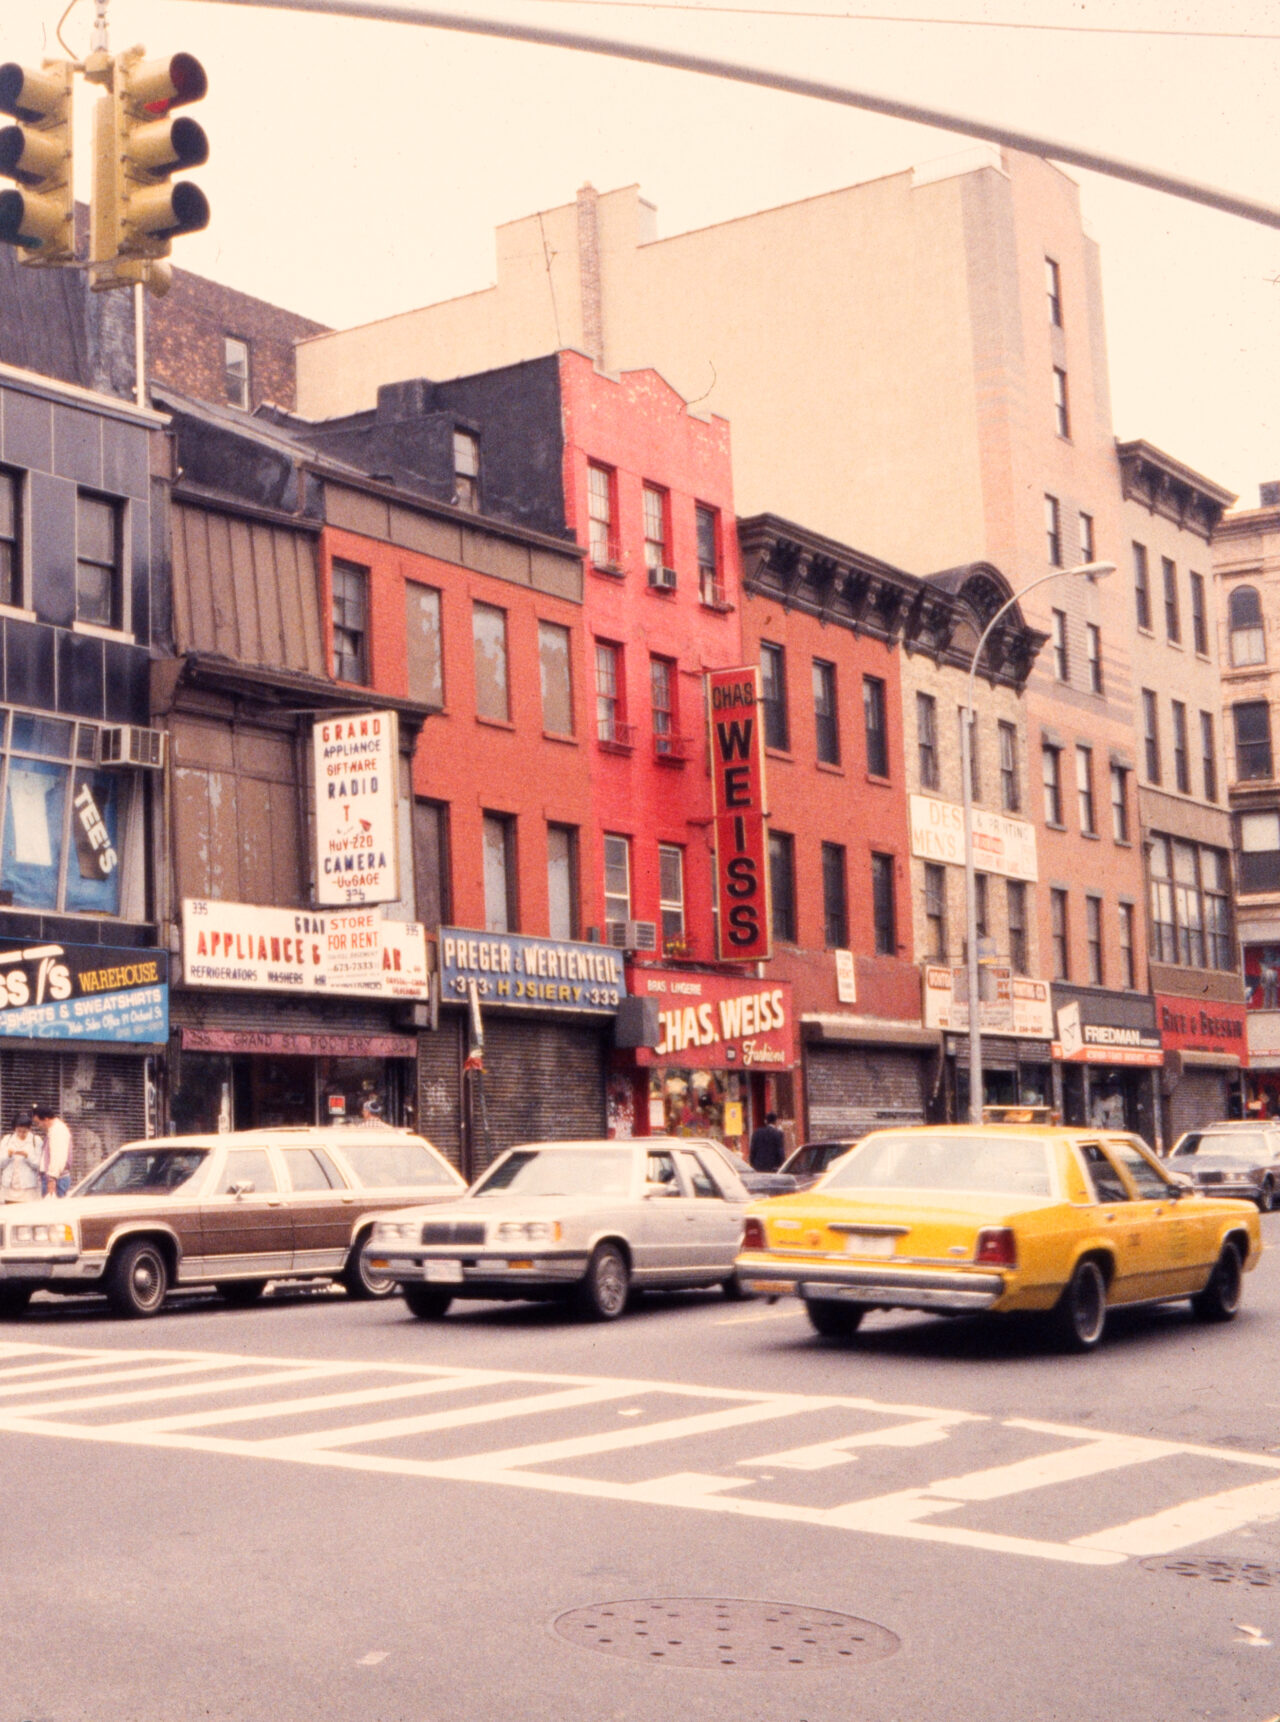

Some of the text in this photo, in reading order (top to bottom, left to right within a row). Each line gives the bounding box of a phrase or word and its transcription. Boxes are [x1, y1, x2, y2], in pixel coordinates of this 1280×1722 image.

[322, 719, 381, 743] GRAND
[324, 740, 381, 758] APPLIANCE
[328, 776, 379, 799] RADIO
[74, 783, 118, 874] TEE'S
[717, 719, 760, 947] WEISS
[324, 852, 387, 875] CAMERA
[192, 902, 209, 916] 335
[331, 915, 374, 931] STORE
[197, 930, 305, 964] APPLIANCE
[327, 931, 378, 951] FOR RENT
[444, 938, 511, 973] PREGER
[524, 945, 619, 984] WERTENTEIL
[78, 961, 159, 993] WAREHOUSE
[190, 965, 258, 982] REFRIGERATORS
[267, 972, 304, 985] WASHERS
[647, 980, 702, 996] BRAS LINGERIE
[59, 1003, 70, 1019] &
[74, 988, 162, 1017] SWEATSHIRTS
[720, 989, 785, 1040] WEISS
[233, 1034, 271, 1048] GRAND
[1084, 1025, 1140, 1046] FRIEDMAN
